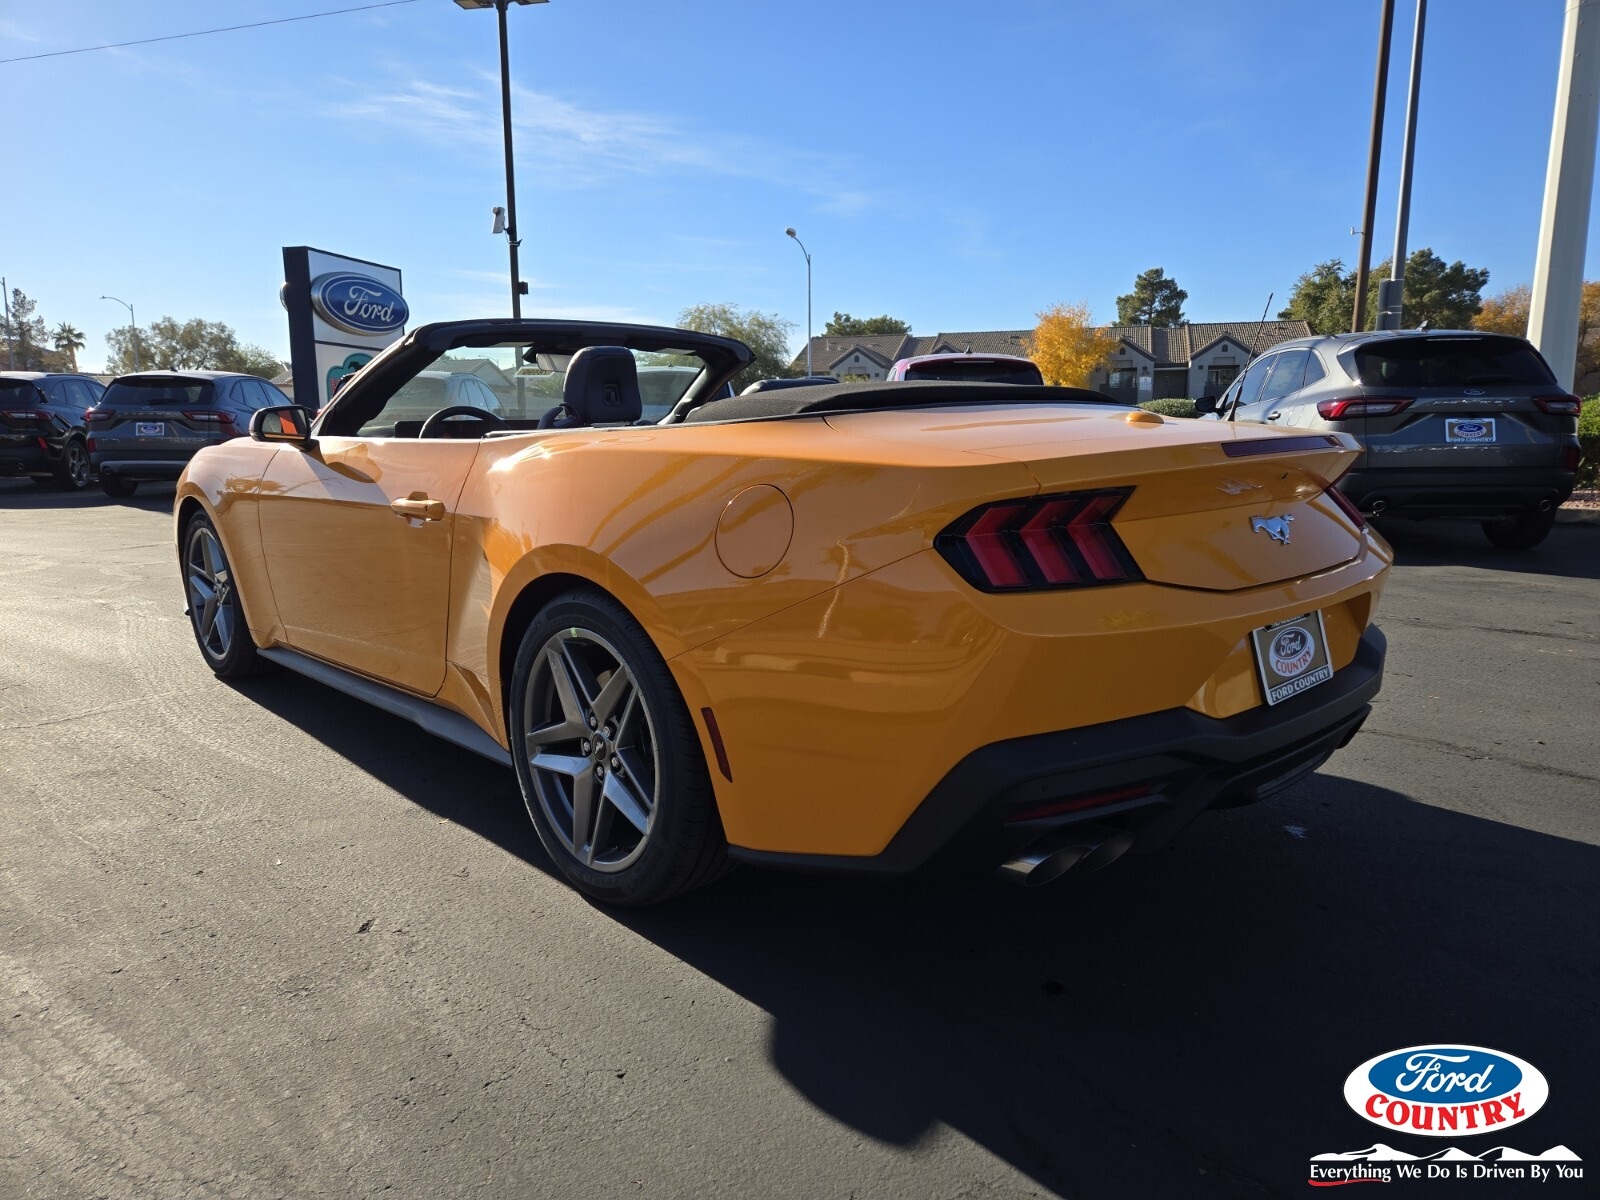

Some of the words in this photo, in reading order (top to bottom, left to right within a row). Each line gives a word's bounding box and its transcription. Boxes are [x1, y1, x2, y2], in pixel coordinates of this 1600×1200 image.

[343, 285, 395, 322] Ford
[1275, 646, 1312, 674] COUNTRY
[1280, 633, 1302, 656] Ford
[1271, 683, 1294, 702] FORD
[1294, 667, 1329, 690] COUNTRY
